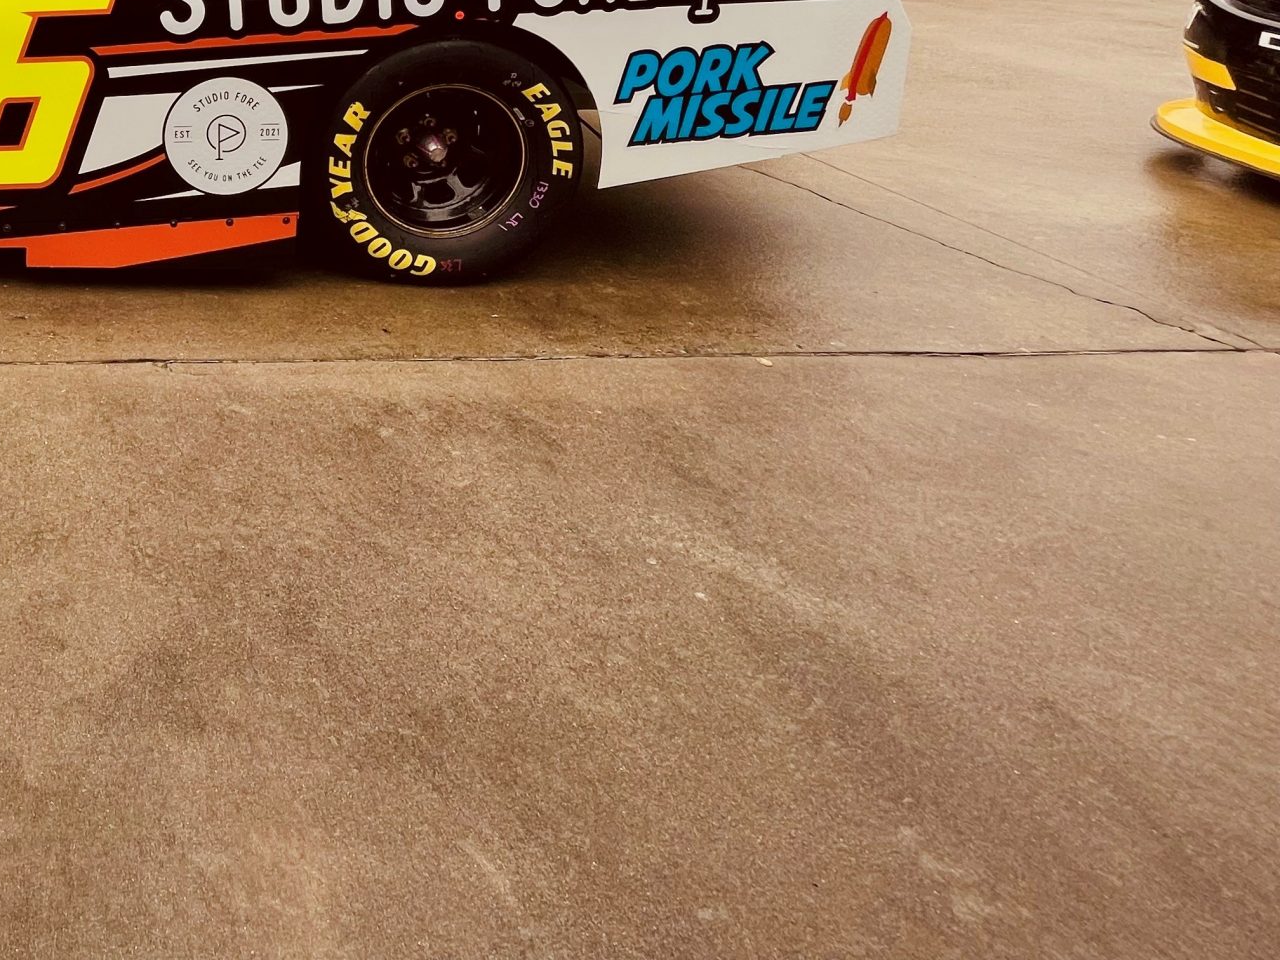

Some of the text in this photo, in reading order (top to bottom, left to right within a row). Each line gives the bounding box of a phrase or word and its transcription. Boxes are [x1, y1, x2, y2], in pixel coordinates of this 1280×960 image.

[613, 41, 776, 105] PORK
[193, 91, 261, 113] STUDIO FORE
[627, 80, 838, 147] MISSILE
[174, 130, 191, 139] EST
[259, 128, 280, 137] 2021
[521, 83, 573, 179] EAGLE
[187, 156, 267, 182] SEE YOU ON THE TEE
[329, 101, 436, 276] GOODYEAR
